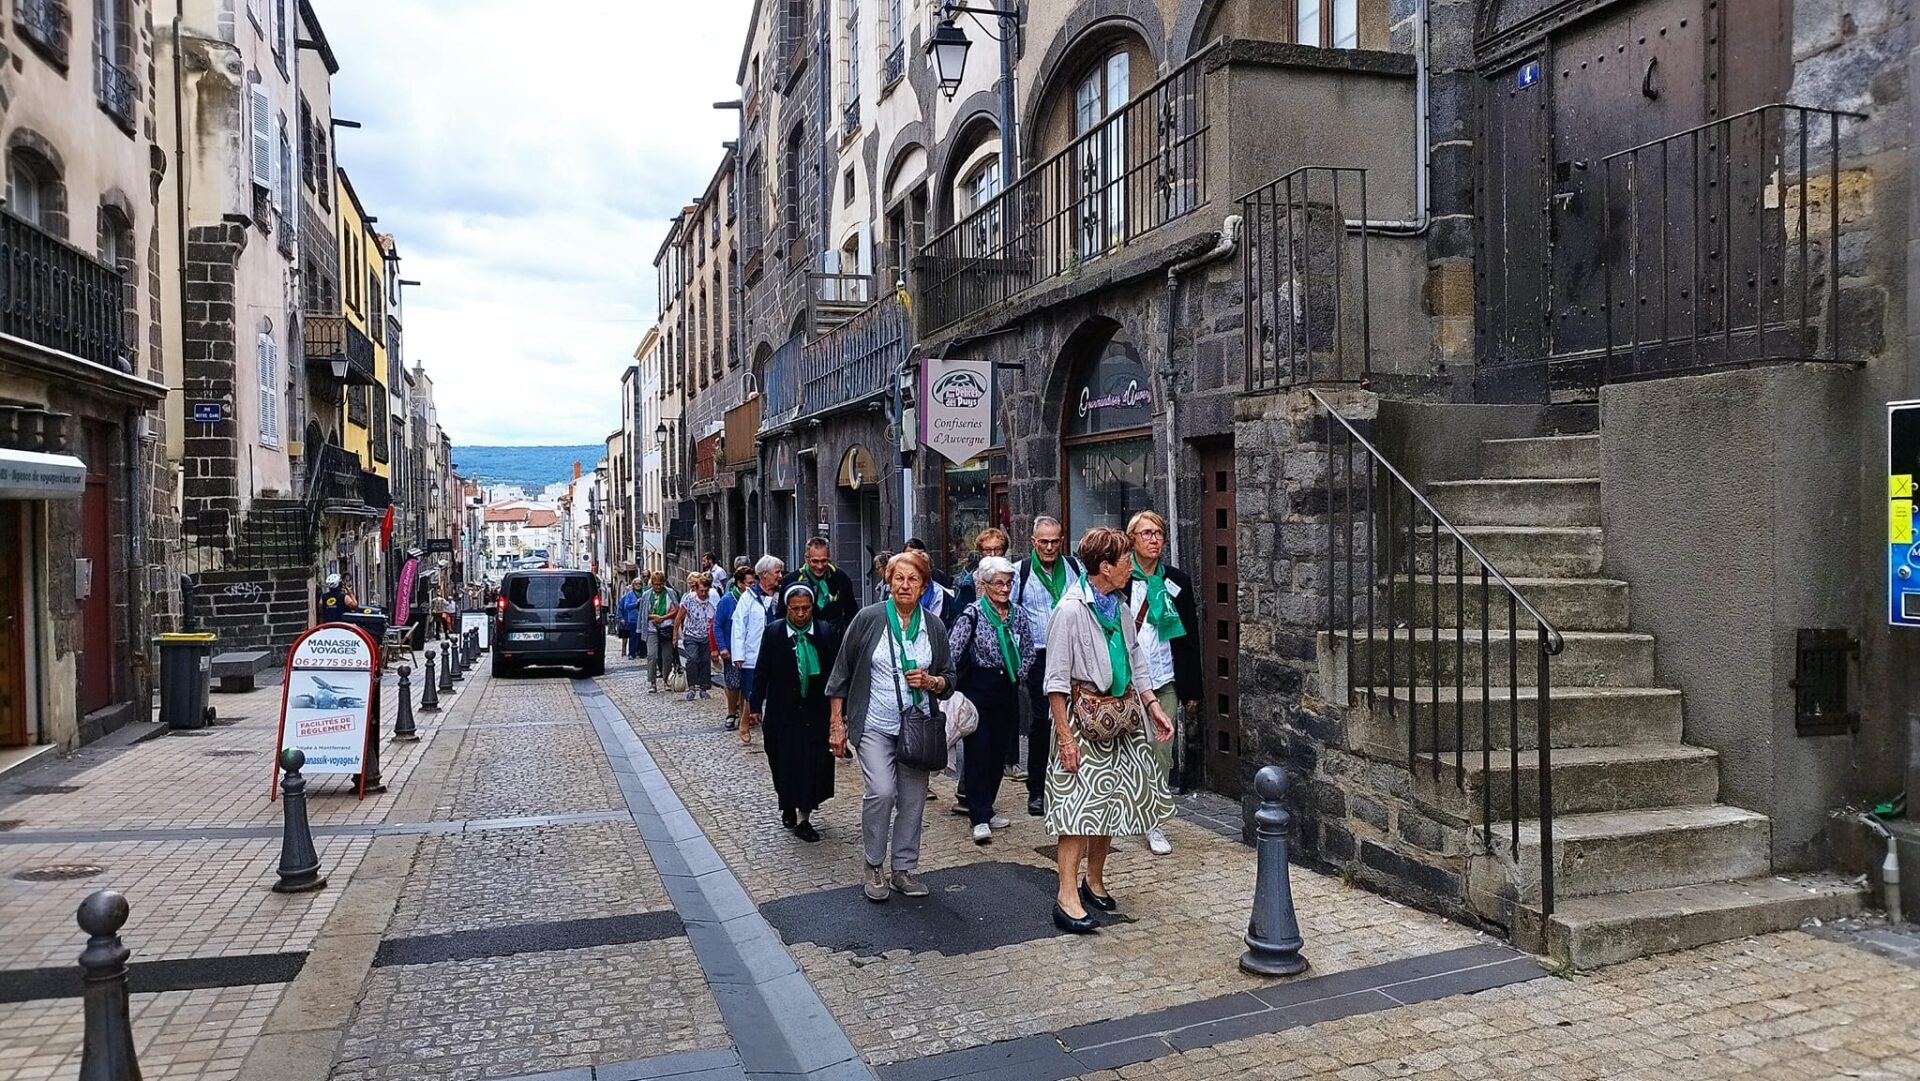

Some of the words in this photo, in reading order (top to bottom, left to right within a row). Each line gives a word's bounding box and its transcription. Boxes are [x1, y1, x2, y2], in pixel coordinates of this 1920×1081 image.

[1524, 66, 1532, 84] 4
[945, 398, 956, 407] des
[957, 396, 977, 407] Puys
[934, 418, 982, 431] Confiseries
[933, 433, 985, 447] d'Auvergne
[307, 639, 361, 648] MANASSIK
[310, 646, 357, 655] VOYAGES
[295, 658, 310, 666] 06
[311, 658, 325, 666] 27
[326, 658, 339, 667] 75
[340, 658, 354, 667] 95
[355, 659, 369, 667] 94
[300, 717, 339, 729] FACILITÉS
[304, 754, 360, 767] anassik-voyages.fr
